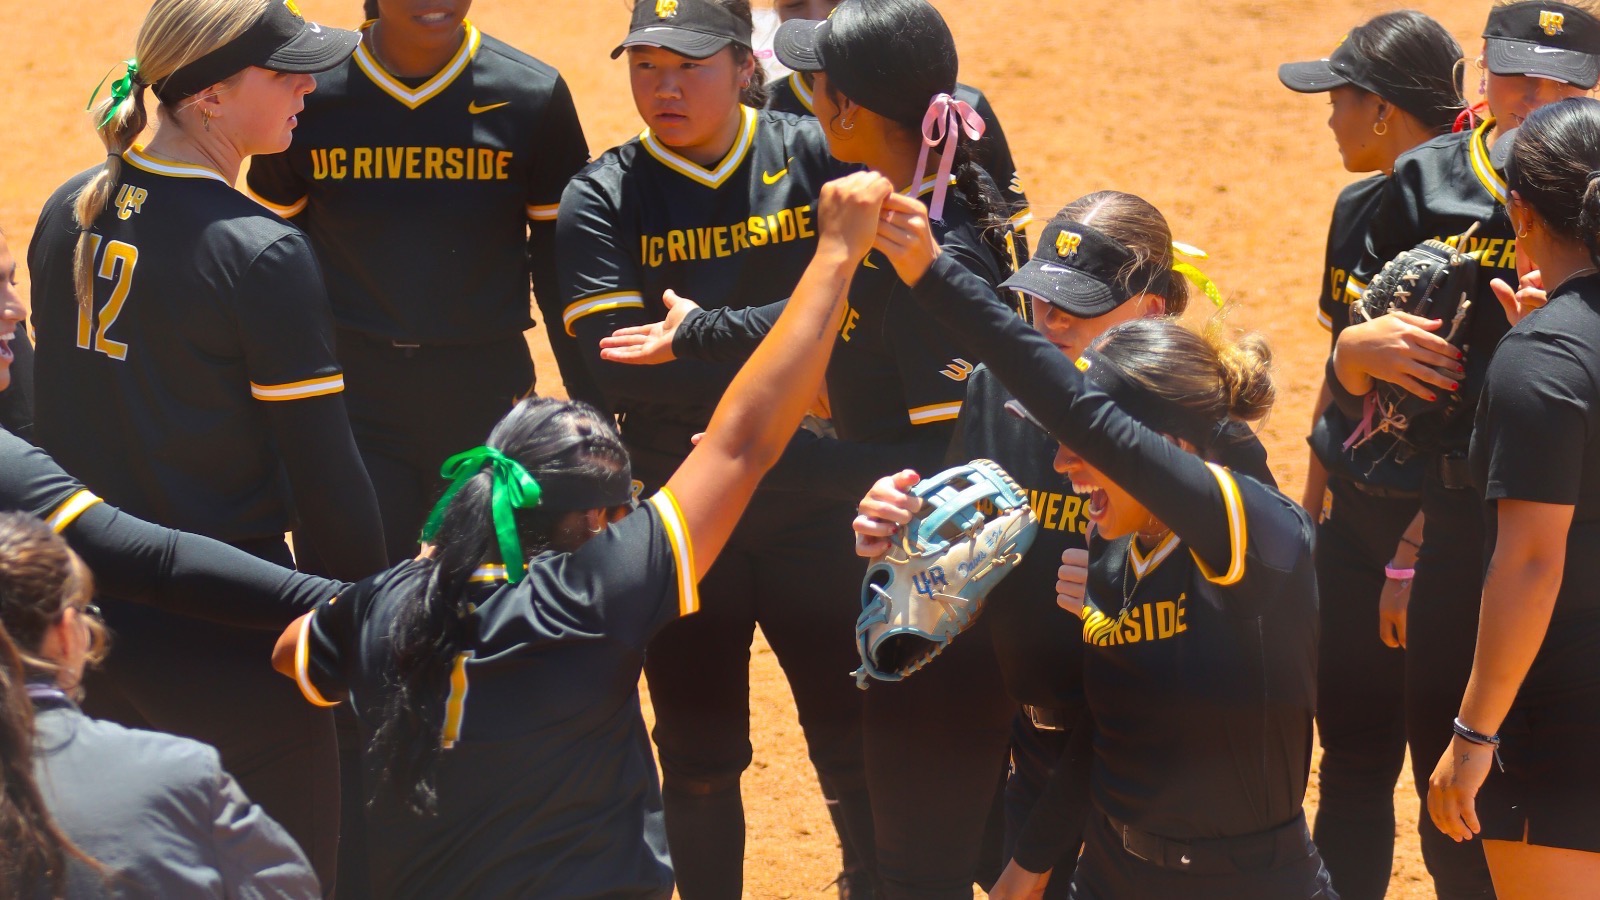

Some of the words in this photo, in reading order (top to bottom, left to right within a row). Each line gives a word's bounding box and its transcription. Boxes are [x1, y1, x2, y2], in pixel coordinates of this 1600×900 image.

[311, 148, 347, 180] UC
[353, 146, 513, 180] RIVERSIDE
[114, 183, 149, 221] UCR
[667, 205, 815, 262] RIVERSIDE
[76, 233, 139, 362] 12
